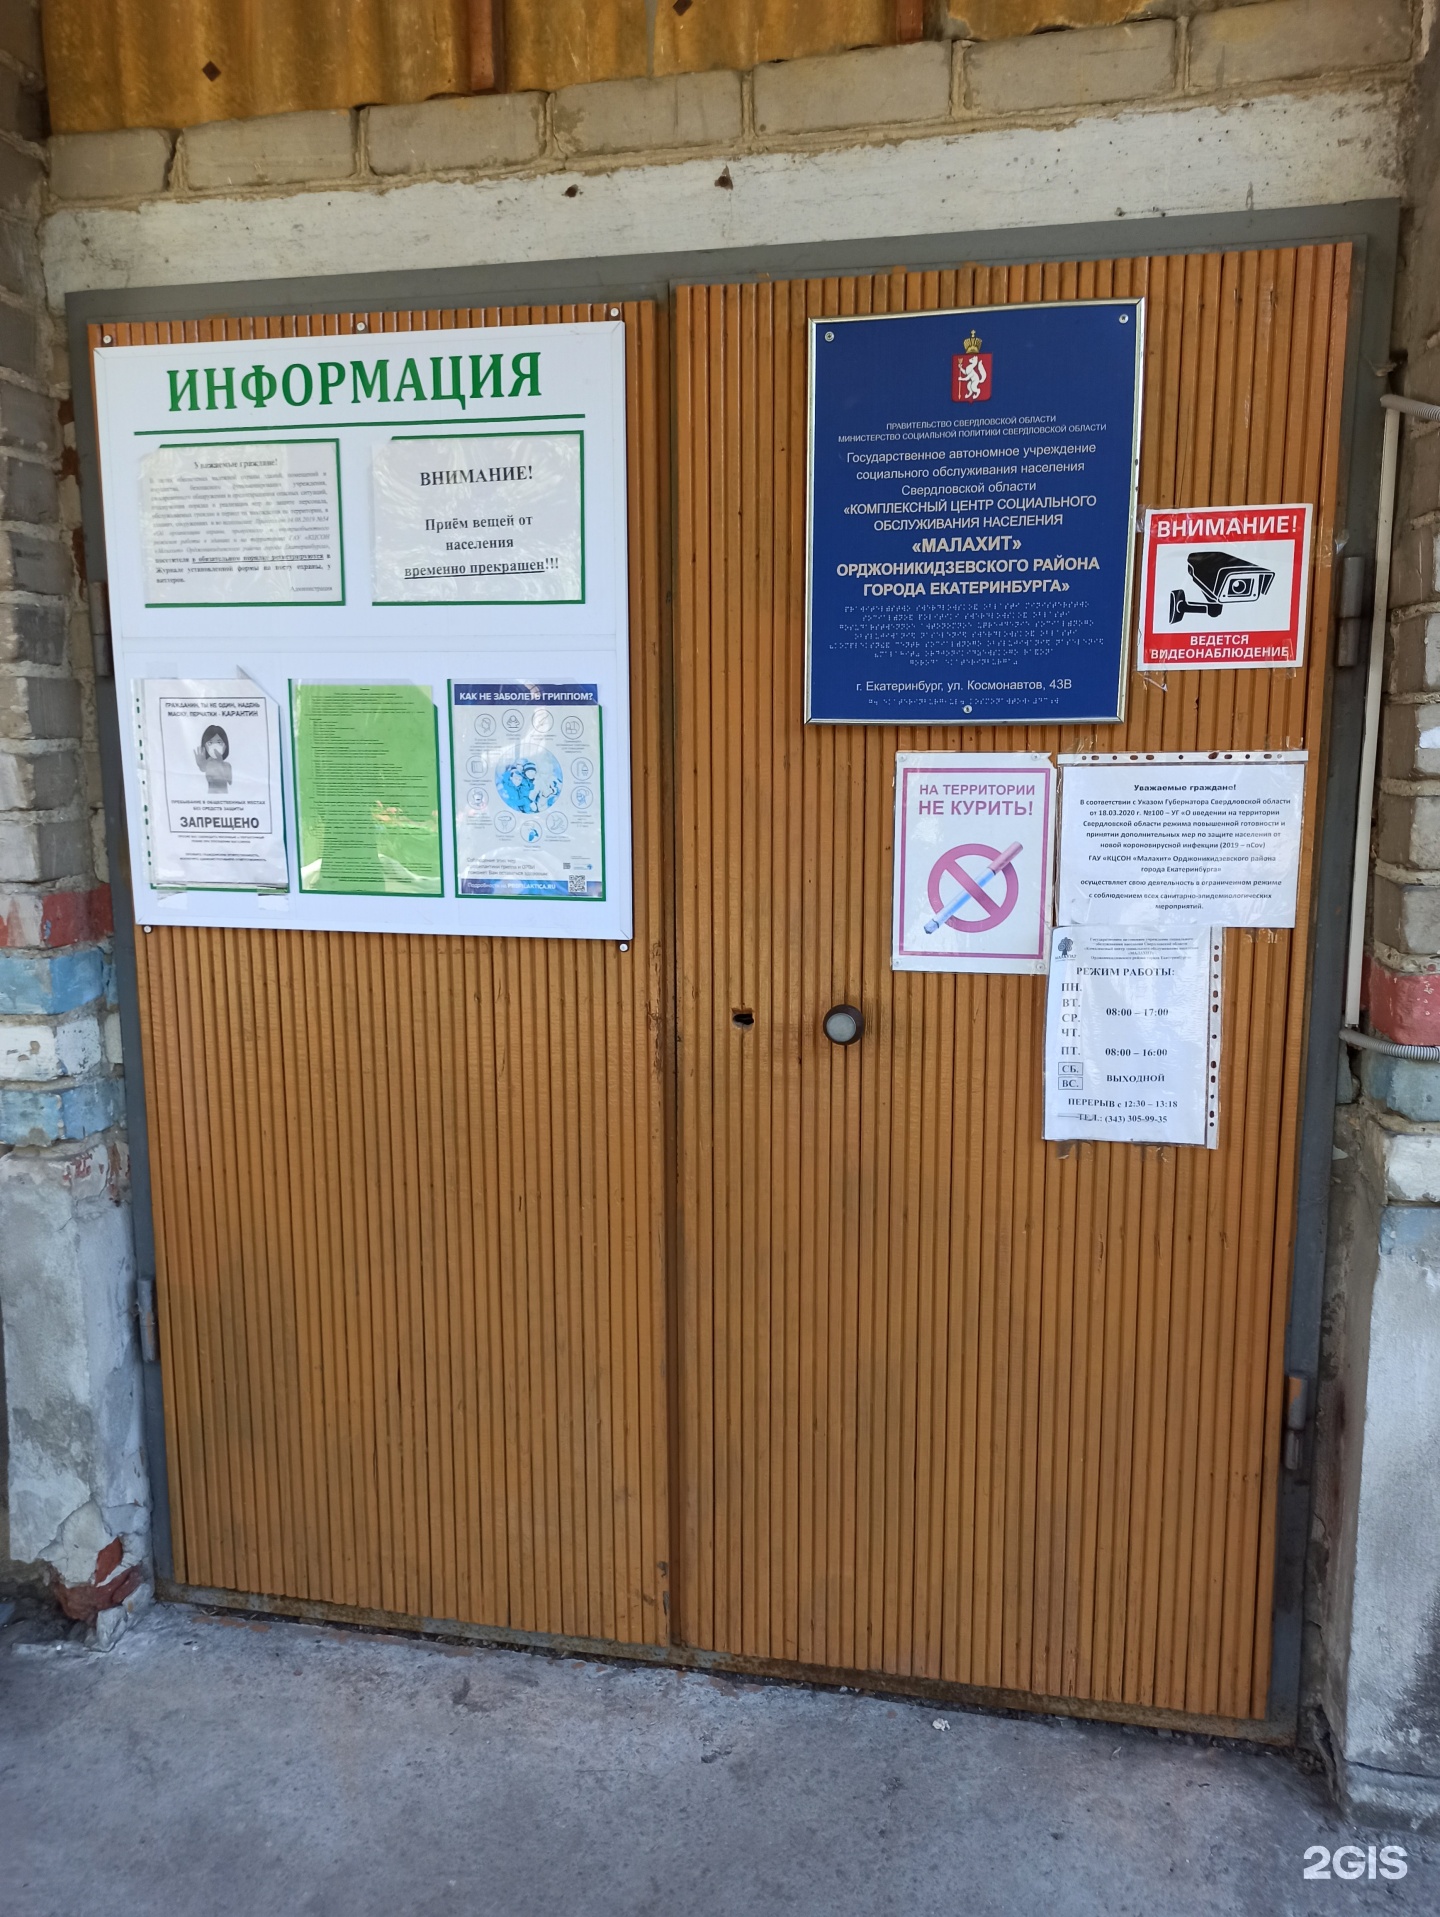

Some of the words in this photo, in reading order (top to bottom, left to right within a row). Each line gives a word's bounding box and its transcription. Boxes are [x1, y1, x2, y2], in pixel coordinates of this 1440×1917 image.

[167, 352, 542, 410] ИНФОРМАЦИЯ
[886, 420, 952, 430] ПРАВИТЕЛЬСТВО
[954, 416, 1017, 428] СВЕРДЛОВСКОЙ
[1019, 415, 1056, 424] ОБЛАСТИ
[838, 432, 900, 443] МИНИСТЕРСТВО
[903, 429, 957, 441] СОЦИАЛЬНОЙ
[959, 428, 1001, 438] ПОЛИТИКИ
[1003, 425, 1066, 437] СВЕРДЛОВСКОЙ
[1069, 424, 1107, 433] ОБЛАСТИ
[847, 449, 945, 465] Государственное
[949, 447, 1020, 459] автономное
[1023, 443, 1096, 458] учреждение
[420, 465, 533, 486] ВНИМАНИЕ!
[856, 467, 929, 481] социального
[933, 464, 1017, 479] обслуживания
[1021, 461, 1085, 474] населения
[901, 483, 985, 497] Свердловской
[988, 480, 1036, 492] области
[844, 498, 947, 515] «КОМПЛЕКСНЫЙ
[951, 500, 993, 515] ЦЕНТР
[997, 495, 1097, 511] СОЦИАЛЬНОГО
[425, 518, 468, 533] Приём
[473, 515, 514, 529] вещей
[519, 516, 533, 526] от
[874, 516, 980, 531] ОБСЛУЖИВАНИЯ
[983, 514, 1063, 528] НАСЕЛЕНИЯ
[1157, 515, 1297, 538] ВНИМАНИЕ!
[446, 538, 514, 551] населения
[912, 535, 1021, 553] «МАЛАХИТ»
[405, 563, 465, 578] временно
[836, 559, 1029, 578] ОРДЖОНИКИДЗЕВСКОГО
[1033, 555, 1100, 571] РАЙОНА
[863, 583, 926, 598] ГОРОДА
[930, 579, 1070, 595] ЕКАТЕРИНБУРГА»
[1190, 634, 1249, 646] ВЕДЕТСЯ
[1151, 646, 1289, 660] ВИДЕОНАБЛЮДЕНИЕ
[856, 683, 862, 692] г.
[866, 680, 944, 693] Екатеринбург,
[948, 681, 962, 693] ул.
[967, 679, 1046, 692] Космонавтов,
[460, 692, 477, 700] КАК
[493, 692, 541, 701] ЗАБОЛЕТЬ
[543, 692, 594, 701] ГРИППОМ?
[920, 785, 939, 795] НА
[943, 785, 1035, 795] ТЕРРИТОРИИ
[919, 800, 944, 815] НЕ
[951, 800, 1033, 816] КУРИТЬ!
[180, 816, 259, 830] ЗАПРЕЩЕНО
[1076, 967, 1119, 976] РЕЖИМ
[1123, 968, 1175, 977] РАБОТЫ:
[1061, 983, 1082, 992] ПН.
[1062, 998, 1080, 1008] ВТ.
[1062, 1014, 1080, 1023] СР.
[1106, 1008, 1132, 1016] 08:00
[1062, 1028, 1080, 1037] ЧТ.
[1062, 1047, 1080, 1056] ПТ.
[1105, 1048, 1131, 1057] 08:00
[1143, 1048, 1168, 1057] 16:00
[1062, 1065, 1079, 1074] СБ.
[1062, 1079, 1079, 1088] ВС.
[1106, 1074, 1165, 1083] ВЫХОДНОЙ
[1068, 1098, 1115, 1108] ПЕРЕРЫВ
[1124, 1100, 1145, 1108] 12:30
[1156, 1100, 1178, 1108] 13:18
[1105, 1115, 1126, 1123] (343)
[1128, 1115, 1167, 1123] 305-99-35
